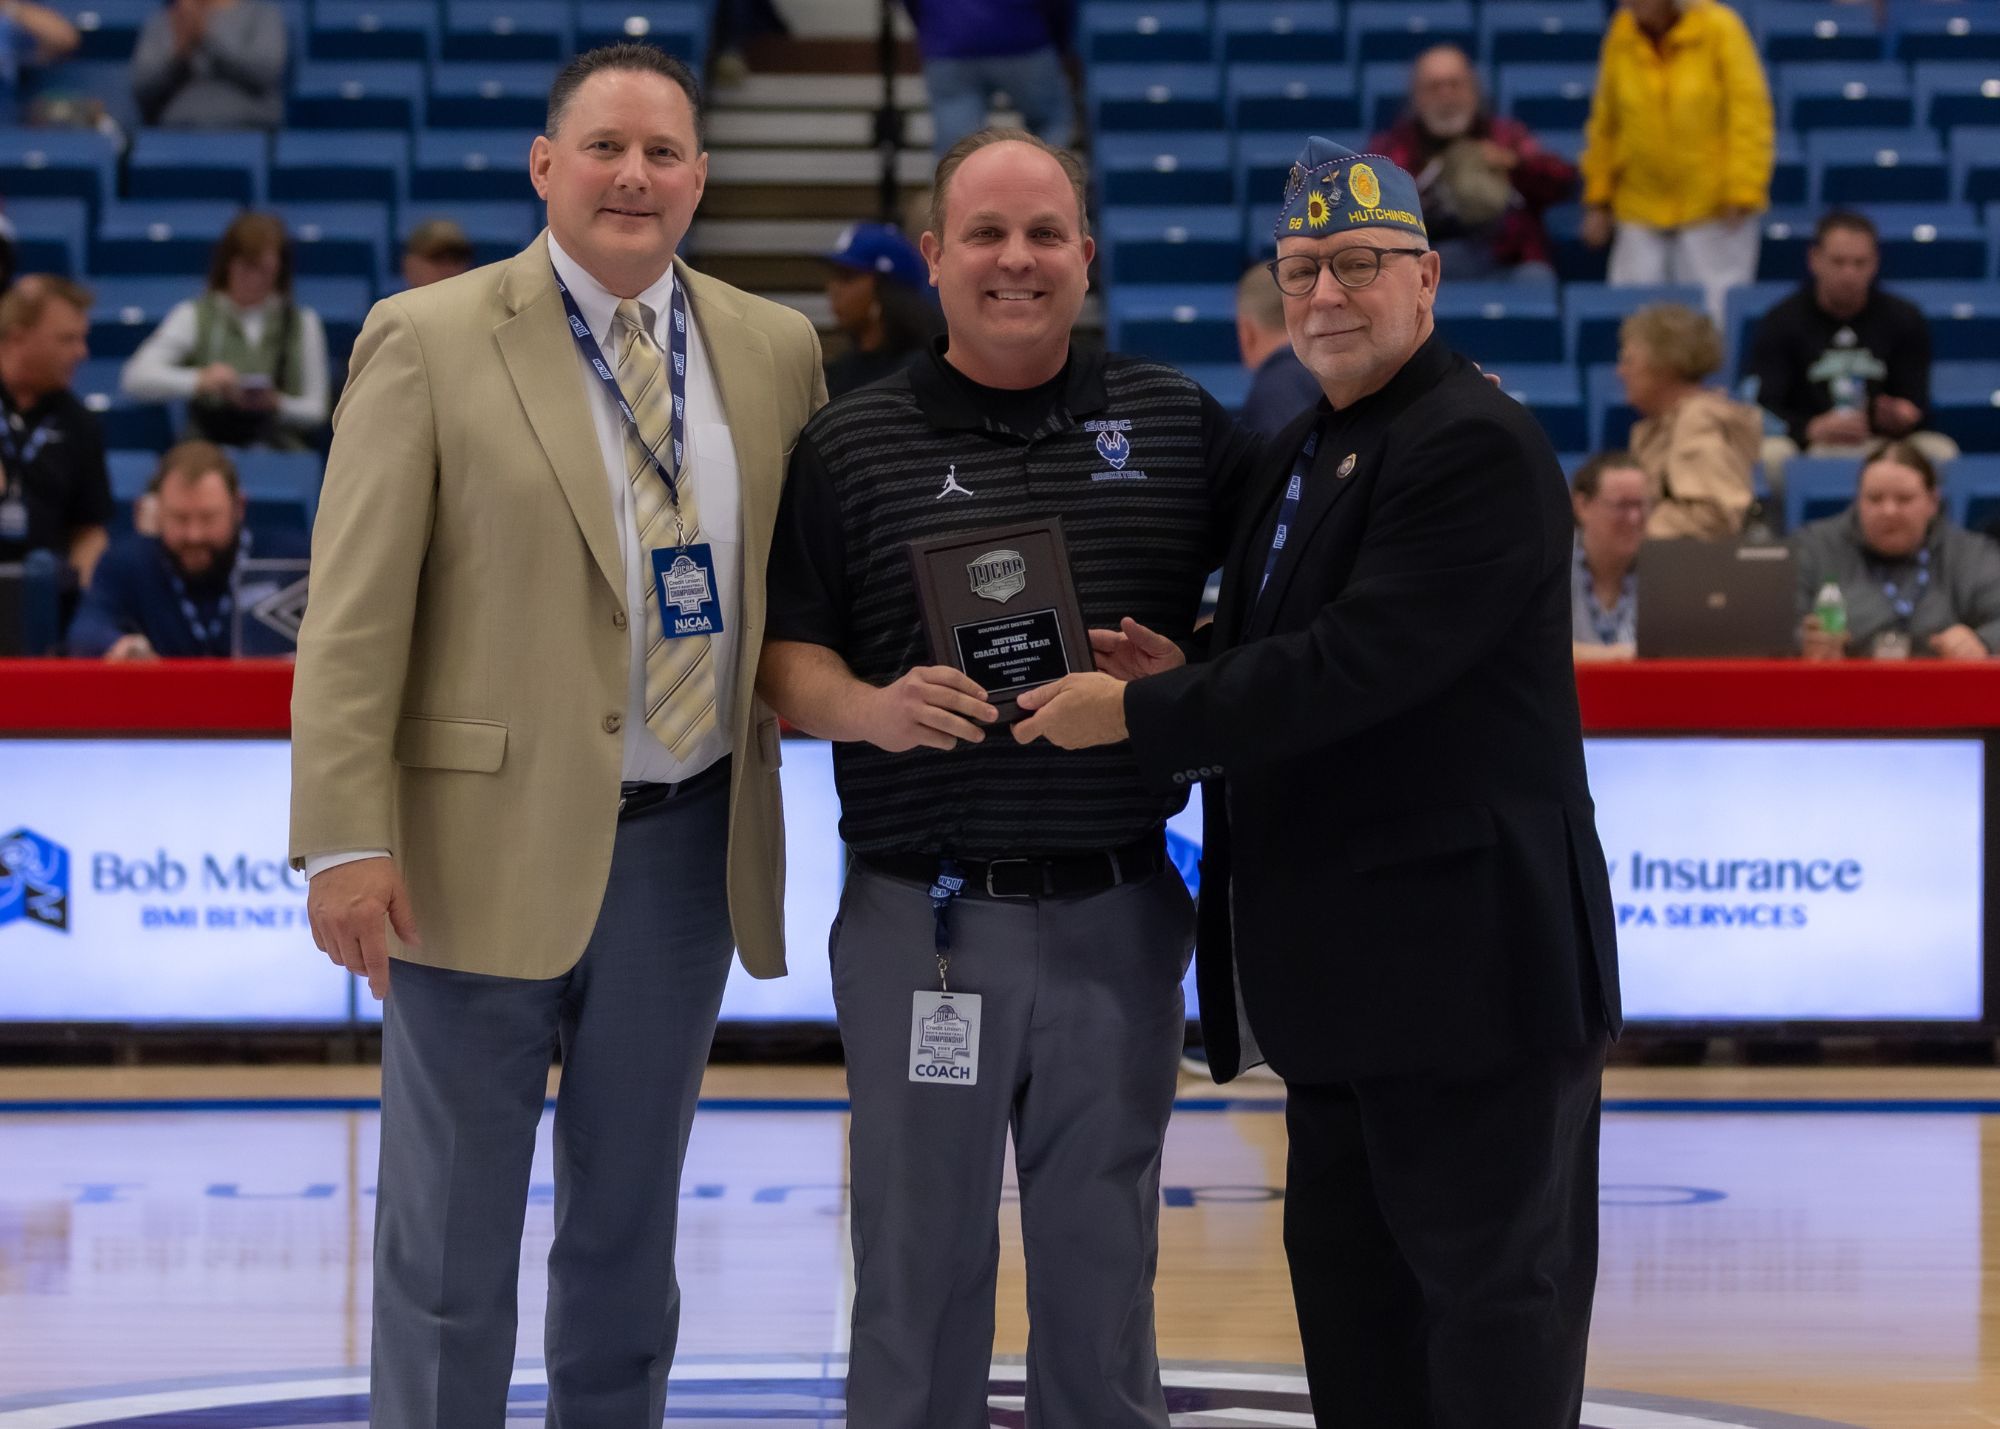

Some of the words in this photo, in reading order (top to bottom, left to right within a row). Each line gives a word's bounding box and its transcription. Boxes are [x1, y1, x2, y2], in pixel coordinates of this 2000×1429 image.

[1288, 217, 1303, 230] 68
[1348, 208, 1418, 225] HUTCHINSON
[969, 557, 1023, 588] NJCAA
[674, 616, 712, 629] NJCAA
[973, 648, 999, 659] COACH
[1001, 645, 1010, 655] OF
[1011, 642, 1029, 652] THE
[1029, 638, 1051, 649] YEAR
[991, 633, 1028, 646] DISTRICT
[92, 848, 187, 893] Bob
[1631, 851, 1864, 893] Insurance
[141, 905, 197, 929] BMI
[205, 905, 309, 929] BENEF
[1664, 904, 1808, 929] SERVICES
[915, 1064, 970, 1079] COACH
